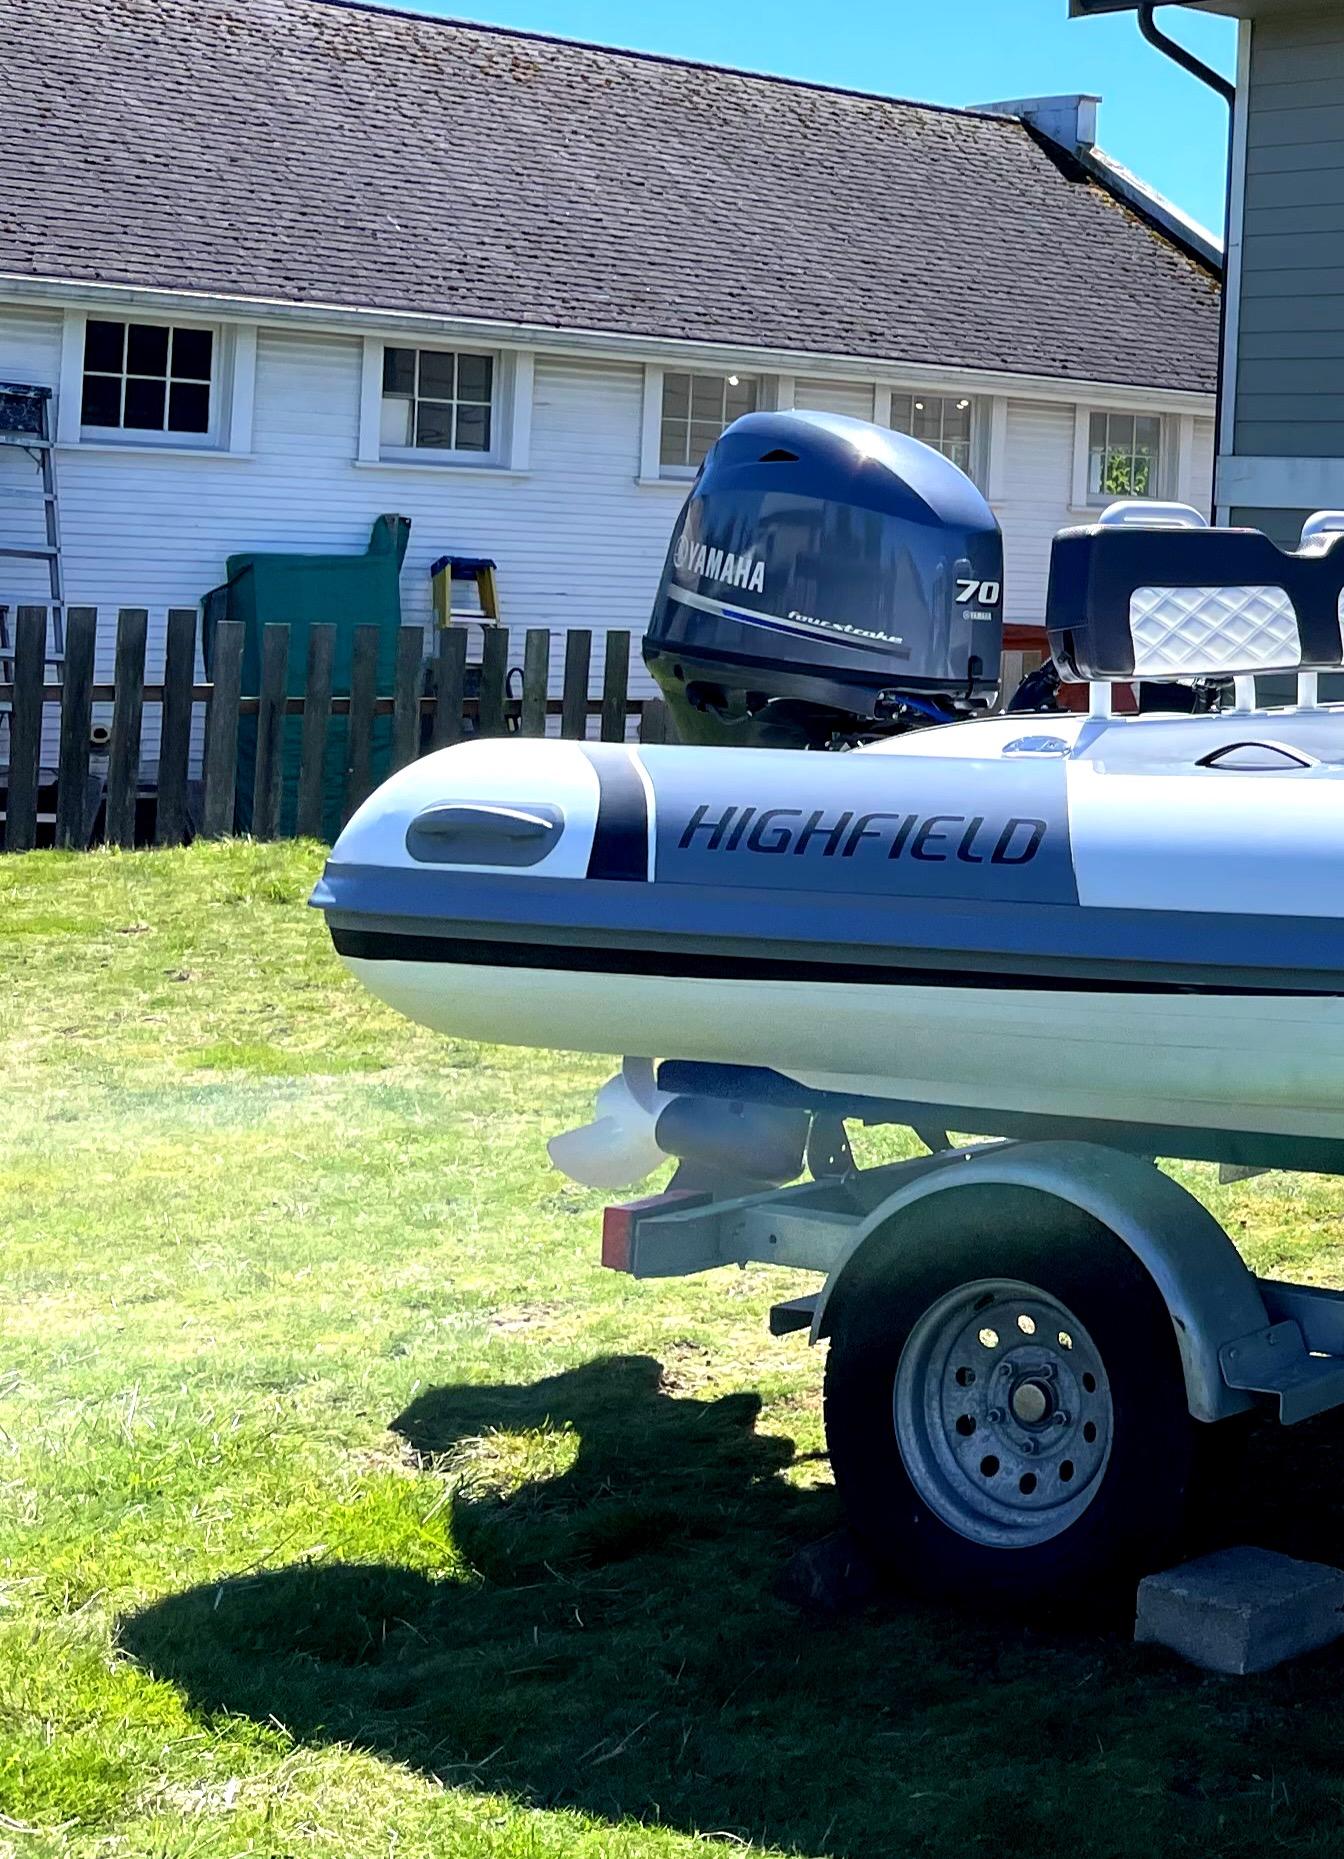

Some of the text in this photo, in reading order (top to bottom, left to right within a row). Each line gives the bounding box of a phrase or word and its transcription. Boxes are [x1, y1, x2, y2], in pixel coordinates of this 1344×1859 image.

[688, 540, 766, 594] YAMAHA
[955, 579, 1000, 604] 70
[677, 804, 1048, 866] HIGHFIELD
